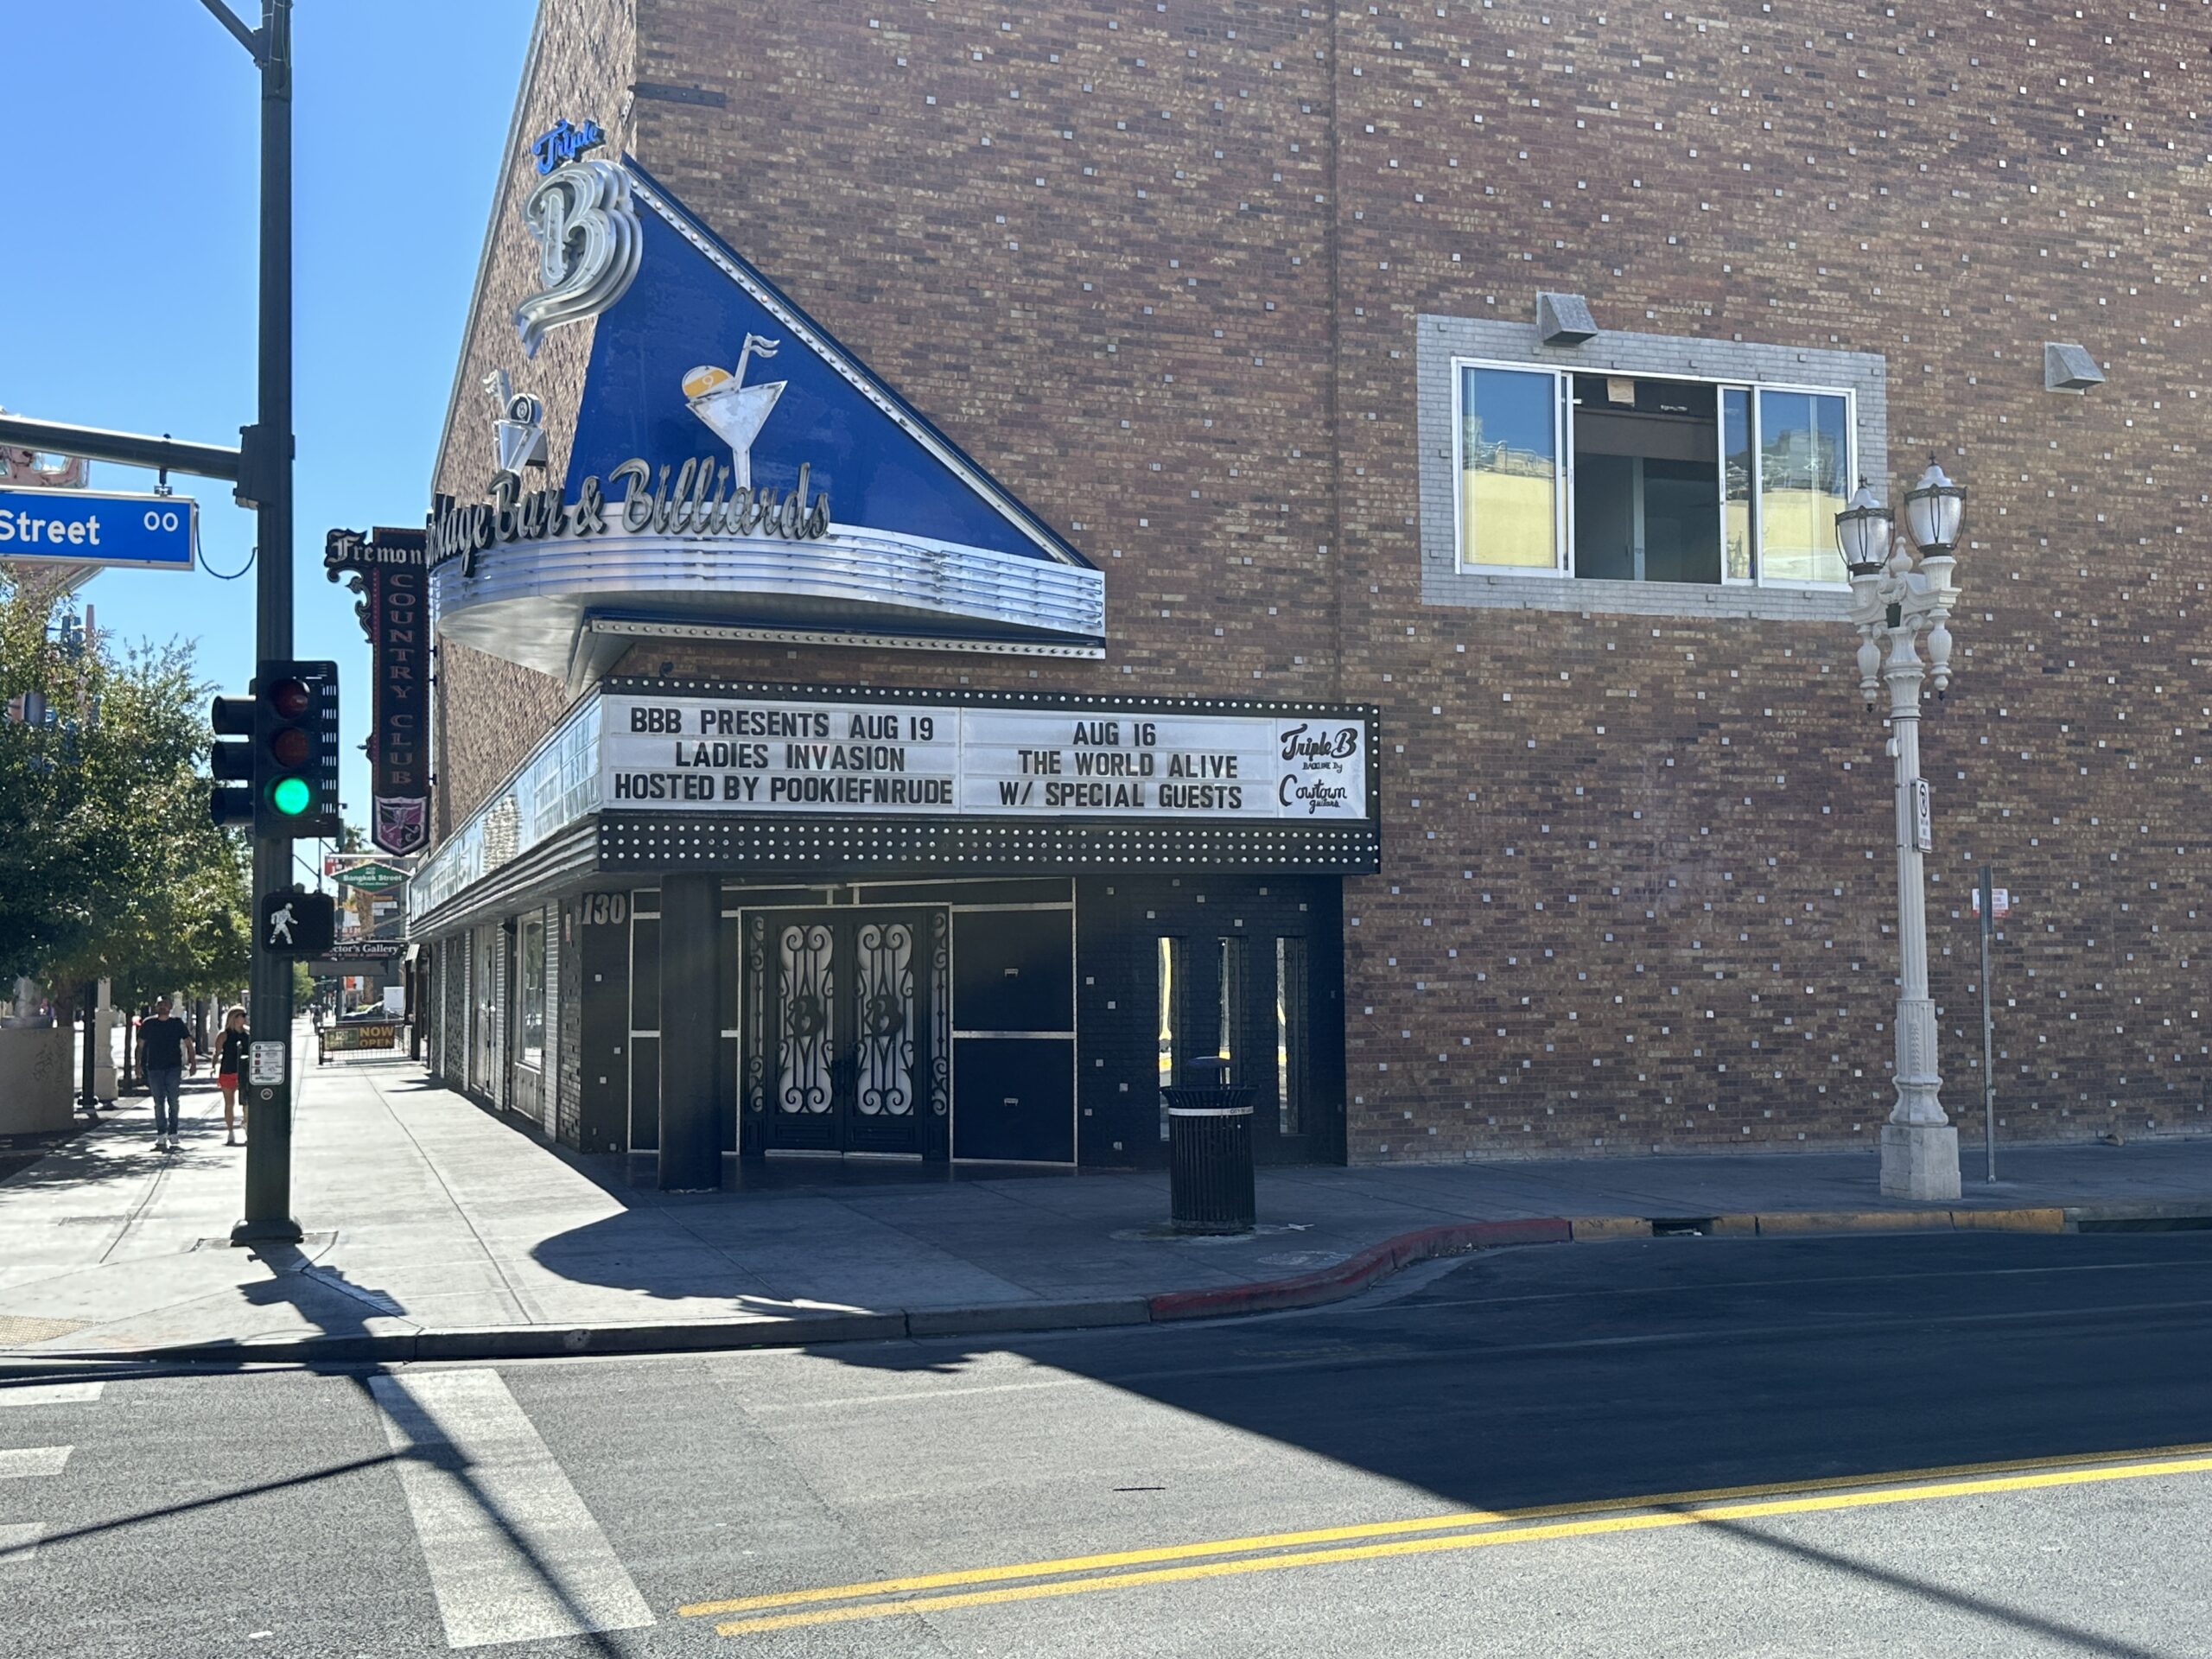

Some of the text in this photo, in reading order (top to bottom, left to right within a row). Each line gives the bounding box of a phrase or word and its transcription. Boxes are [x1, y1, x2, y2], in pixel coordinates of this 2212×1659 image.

[513, 160, 643, 359] B
[487, 468, 566, 543] Bar
[570, 475, 607, 537] &
[608, 455, 830, 540] Billiards
[0, 509, 100, 545] Street
[328, 532, 427, 565] Fremon
[389, 574, 416, 785] COUNTRY CLUB
[631, 707, 934, 741] BBB PRESENTS AUG 19
[1072, 721, 1156, 747] AUG 16
[676, 741, 905, 772] LADIES INVASION
[1281, 723, 1358, 761] Triple B
[1018, 749, 1237, 779] THE WORLD ALIVE
[614, 772, 953, 804] HOSTED BY POOKIEFNRUDE
[999, 780, 1242, 810] W/ SPECIAL GUESTS
[1279, 774, 1348, 807] Cowtown
[582, 893, 626, 925] 130
[362, 944, 399, 955] Gallery
[359, 1026, 395, 1038] NOW
[359, 1037, 394, 1048] OPEN
